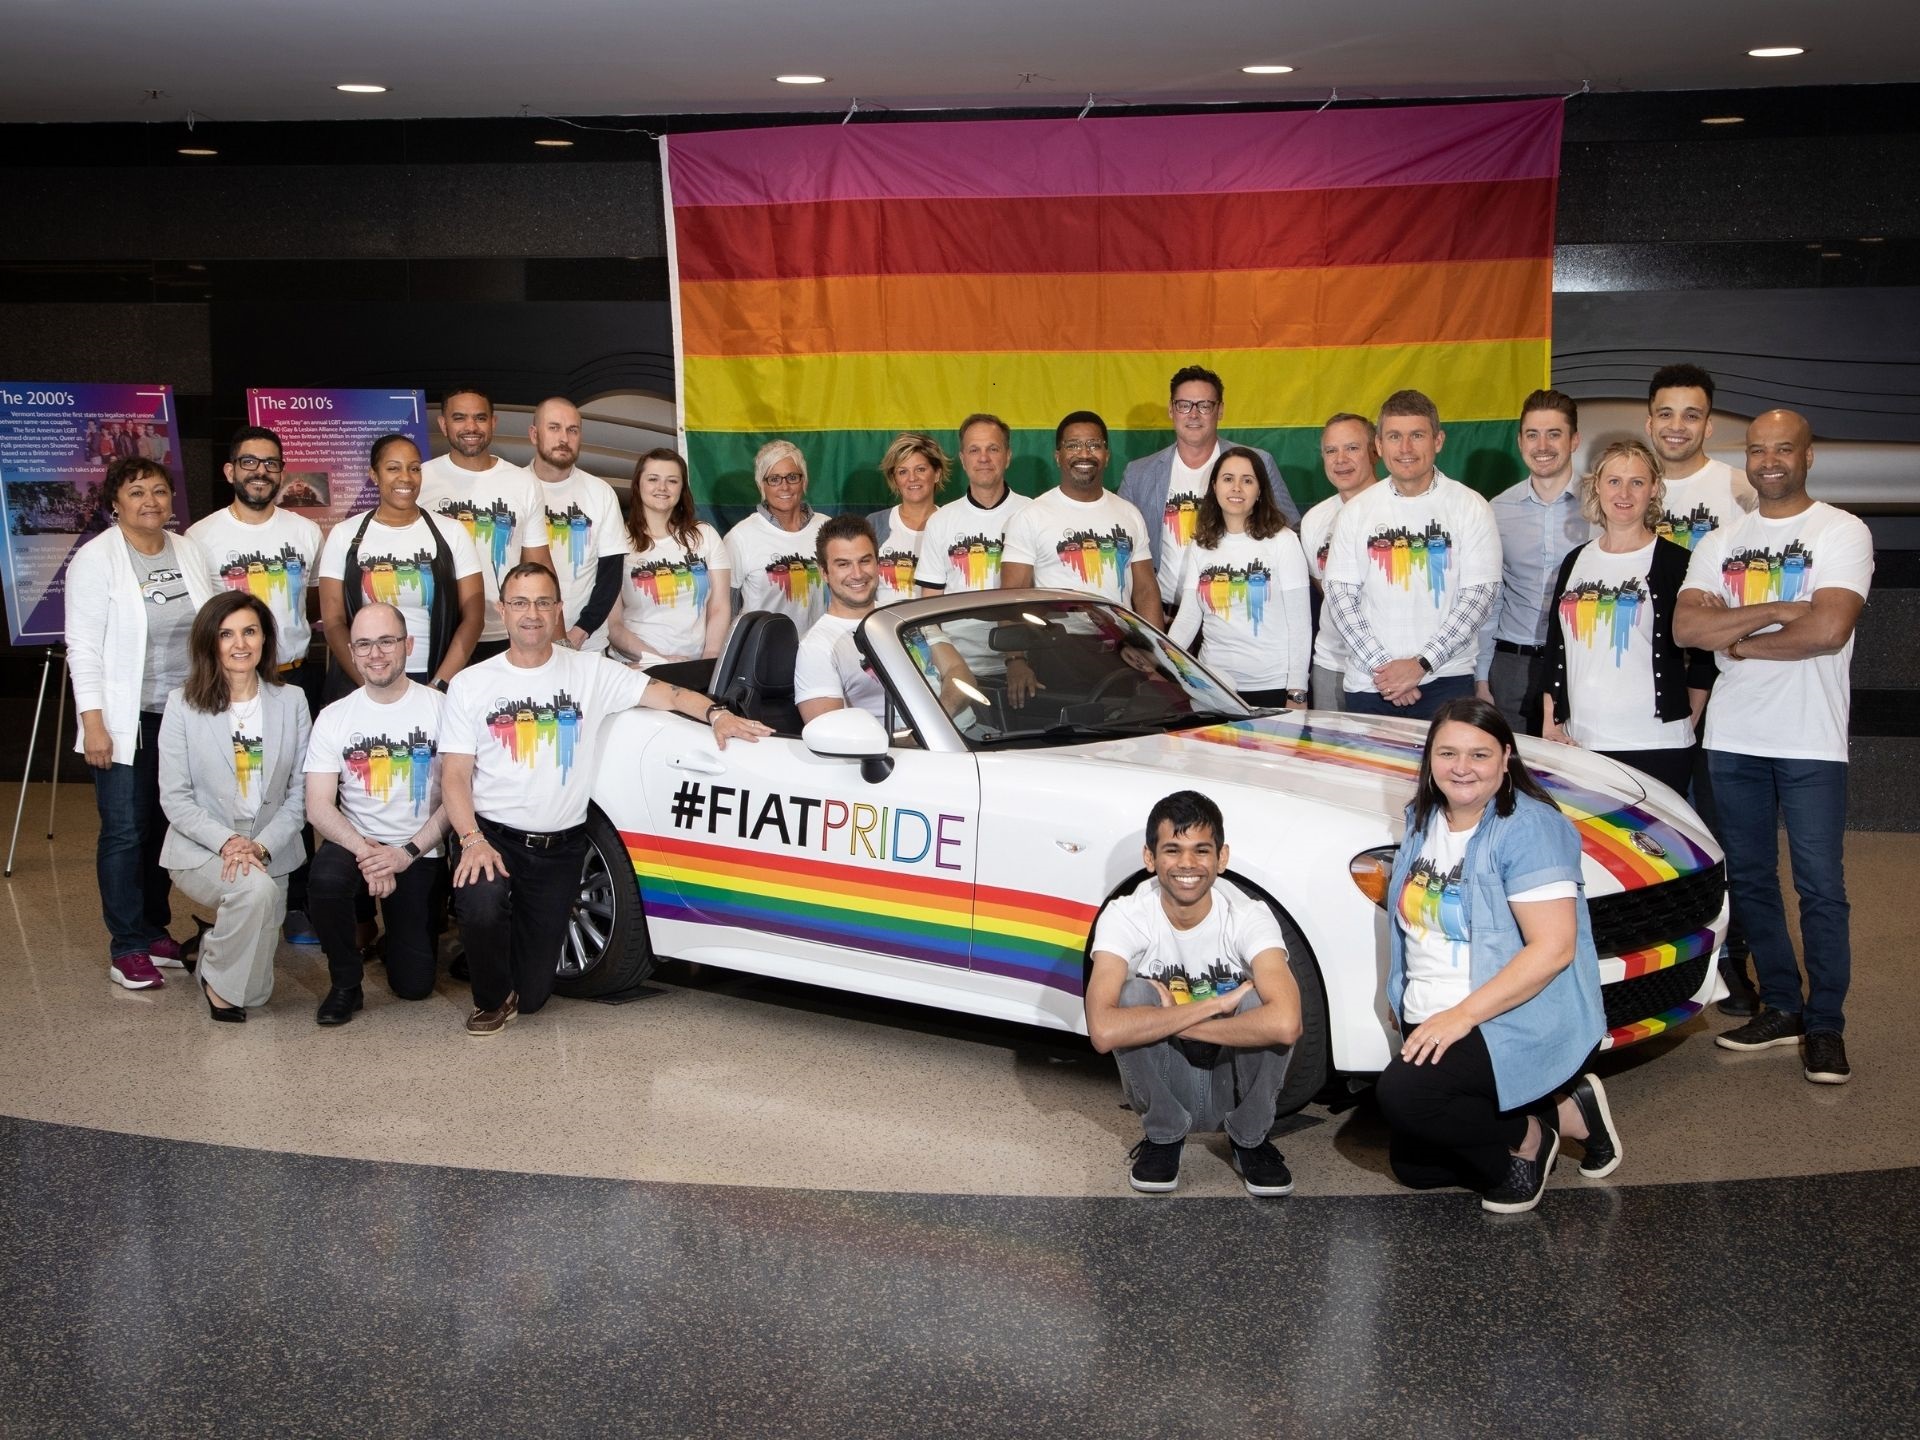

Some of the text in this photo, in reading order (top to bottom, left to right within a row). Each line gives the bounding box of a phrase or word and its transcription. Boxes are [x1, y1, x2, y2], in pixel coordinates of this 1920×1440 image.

[27, 391, 75, 406] 2000's
[259, 396, 333, 410] The 2010's
[671, 781, 965, 870] #FIATPRIDE
